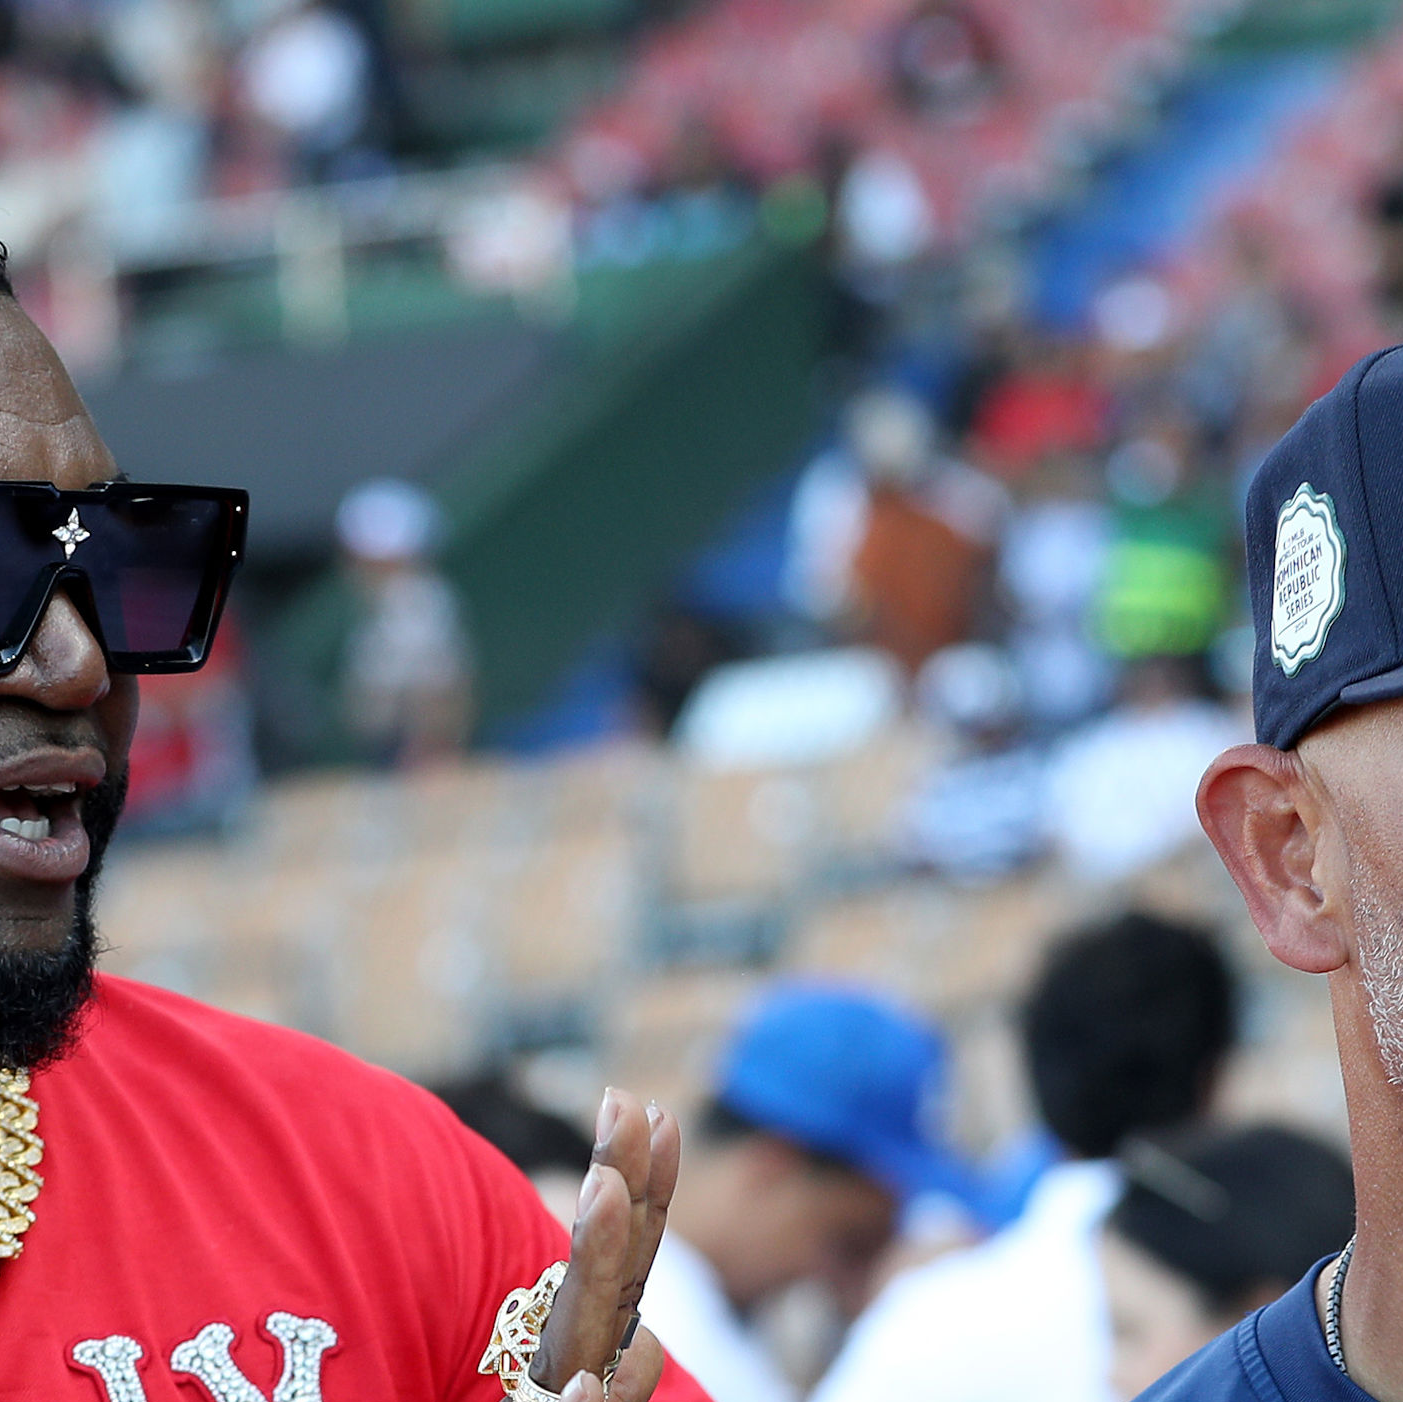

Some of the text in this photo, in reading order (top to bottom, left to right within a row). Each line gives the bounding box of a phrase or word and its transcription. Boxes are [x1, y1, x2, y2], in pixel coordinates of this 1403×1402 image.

[1276, 541, 1323, 591] DOMINICAN
[1279, 564, 1320, 608] REPUBLIC
[1285, 590, 1314, 620] SERIES
